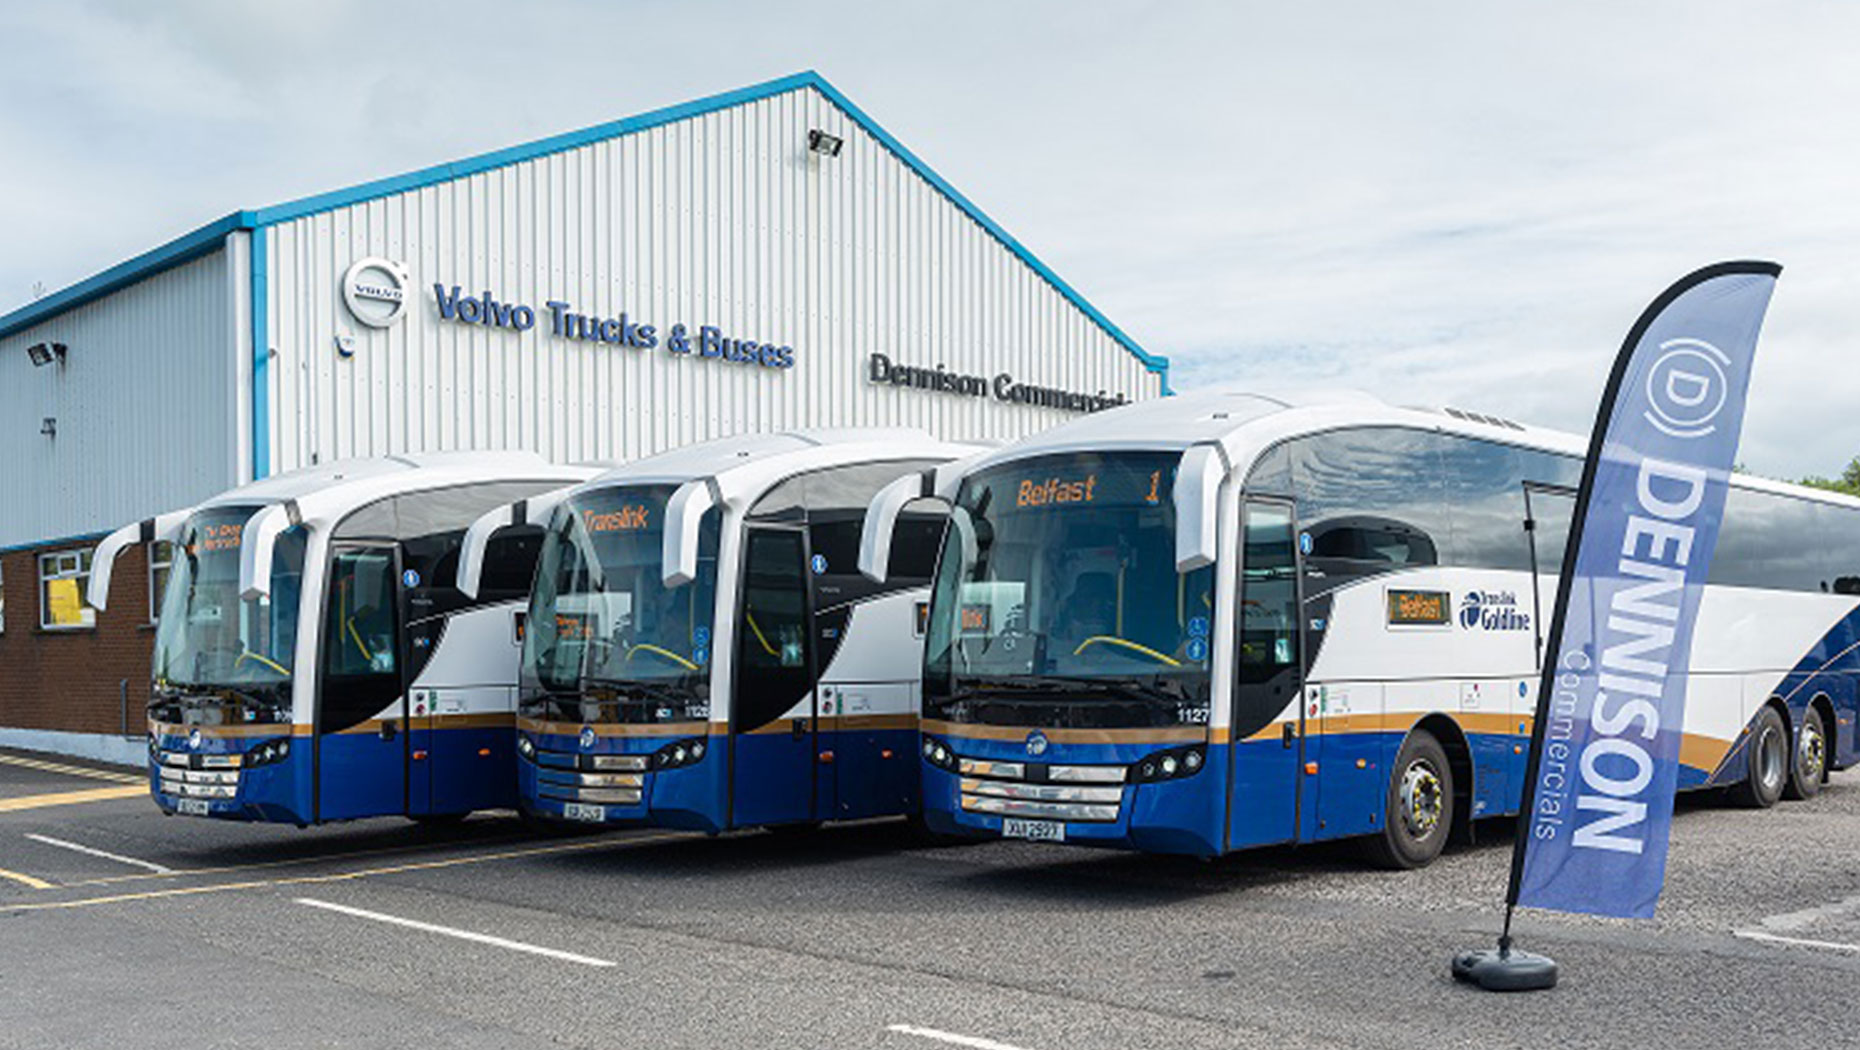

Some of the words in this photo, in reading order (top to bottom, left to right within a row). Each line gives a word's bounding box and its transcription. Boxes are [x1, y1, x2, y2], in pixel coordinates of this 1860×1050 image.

[354, 284, 403, 298] VOLVO
[433, 282, 535, 332] Volvo
[546, 300, 659, 349] Trucks
[668, 322, 691, 354] &
[700, 325, 794, 369] Buses
[869, 353, 987, 397] Dennison
[993, 373, 1133, 413] Commercial
[1016, 474, 1096, 507] Belfast
[1145, 470, 1161, 501] 1
[583, 504, 649, 532] Translink
[1399, 593, 1441, 620] Belfast
[1481, 607, 1531, 631] Goldline
[1571, 457, 1707, 855] DENNISON
[1177, 708, 1209, 722] 1127
[1535, 650, 1592, 841] Commercials
